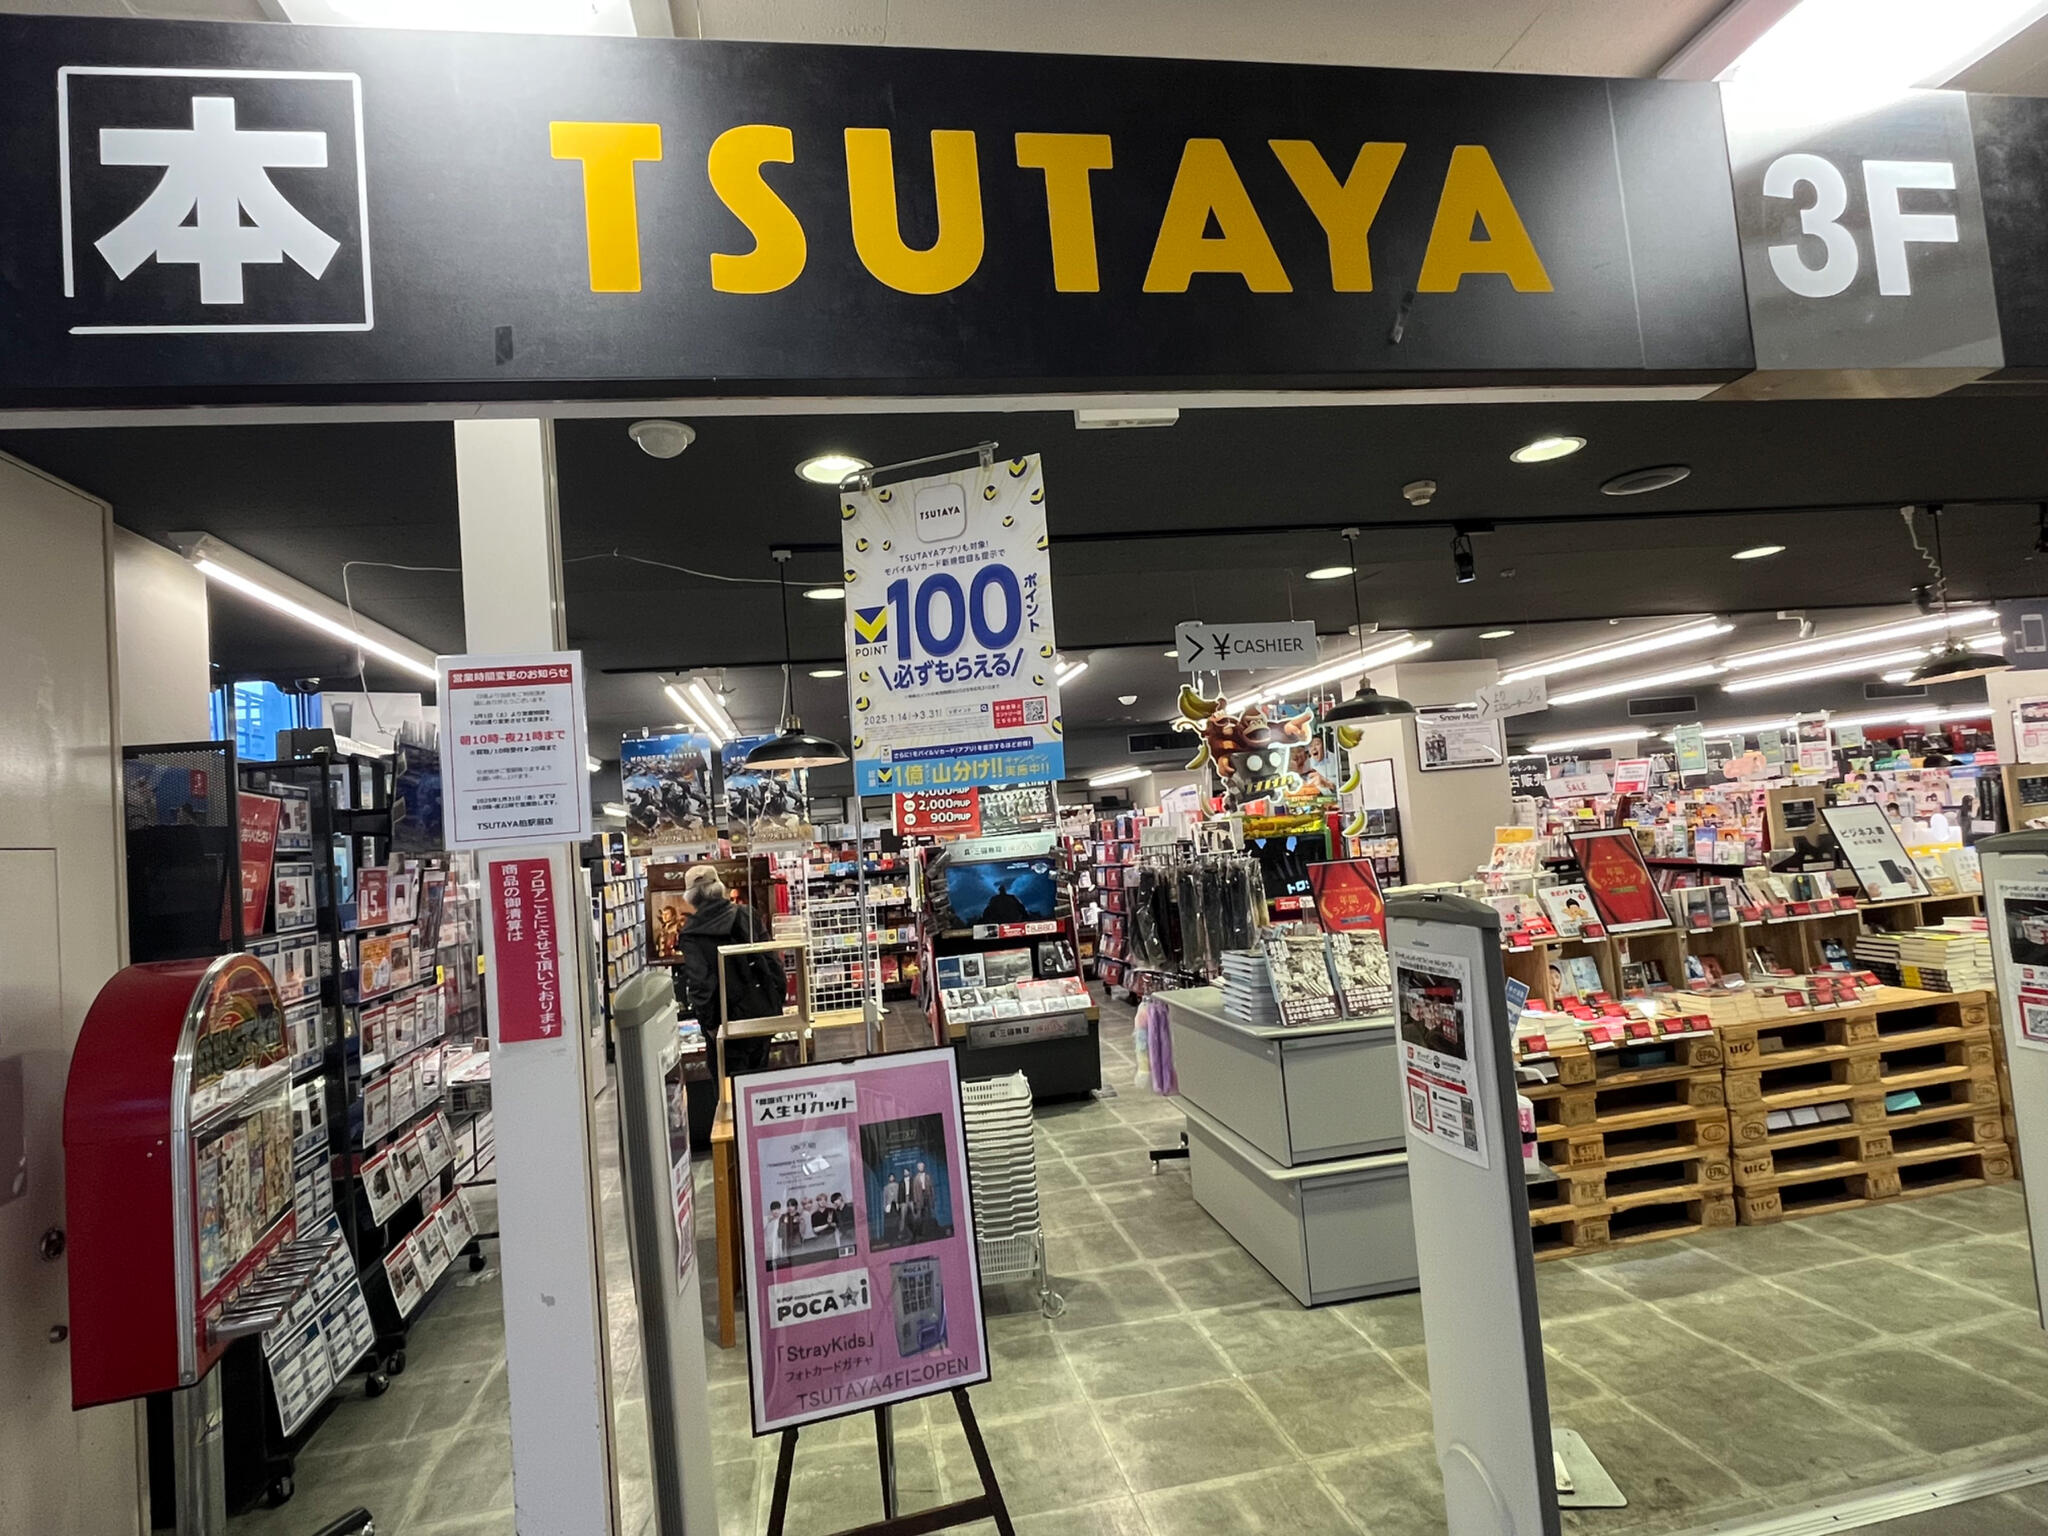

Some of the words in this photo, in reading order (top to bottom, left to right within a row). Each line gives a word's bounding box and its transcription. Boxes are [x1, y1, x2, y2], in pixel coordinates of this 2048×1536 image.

[94, 97, 341, 304] 本
[549, 120, 1555, 295] TSUTAYA
[1761, 151, 1960, 300] 3F
[919, 505, 961, 520] TSUTAYA
[887, 563, 1022, 661] 100
[1023, 572, 1040, 633] ポイント
[855, 645, 889, 657] POINT
[1233, 638, 1304, 654] CASHIER
[453, 668, 569, 683] 営業時間変更のお知らせ
[893, 652, 1011, 691] 必ずもらえる
[1566, 782, 1588, 793] SALE
[530, 869, 557, 1036] フロアごとにさせて頂いております
[760, 1096, 855, 1122] 人生4カット
[784, 1355, 873, 1384] フォトカードガチャ
[796, 1355, 970, 1411] TSUTAYA4FにOPEN
